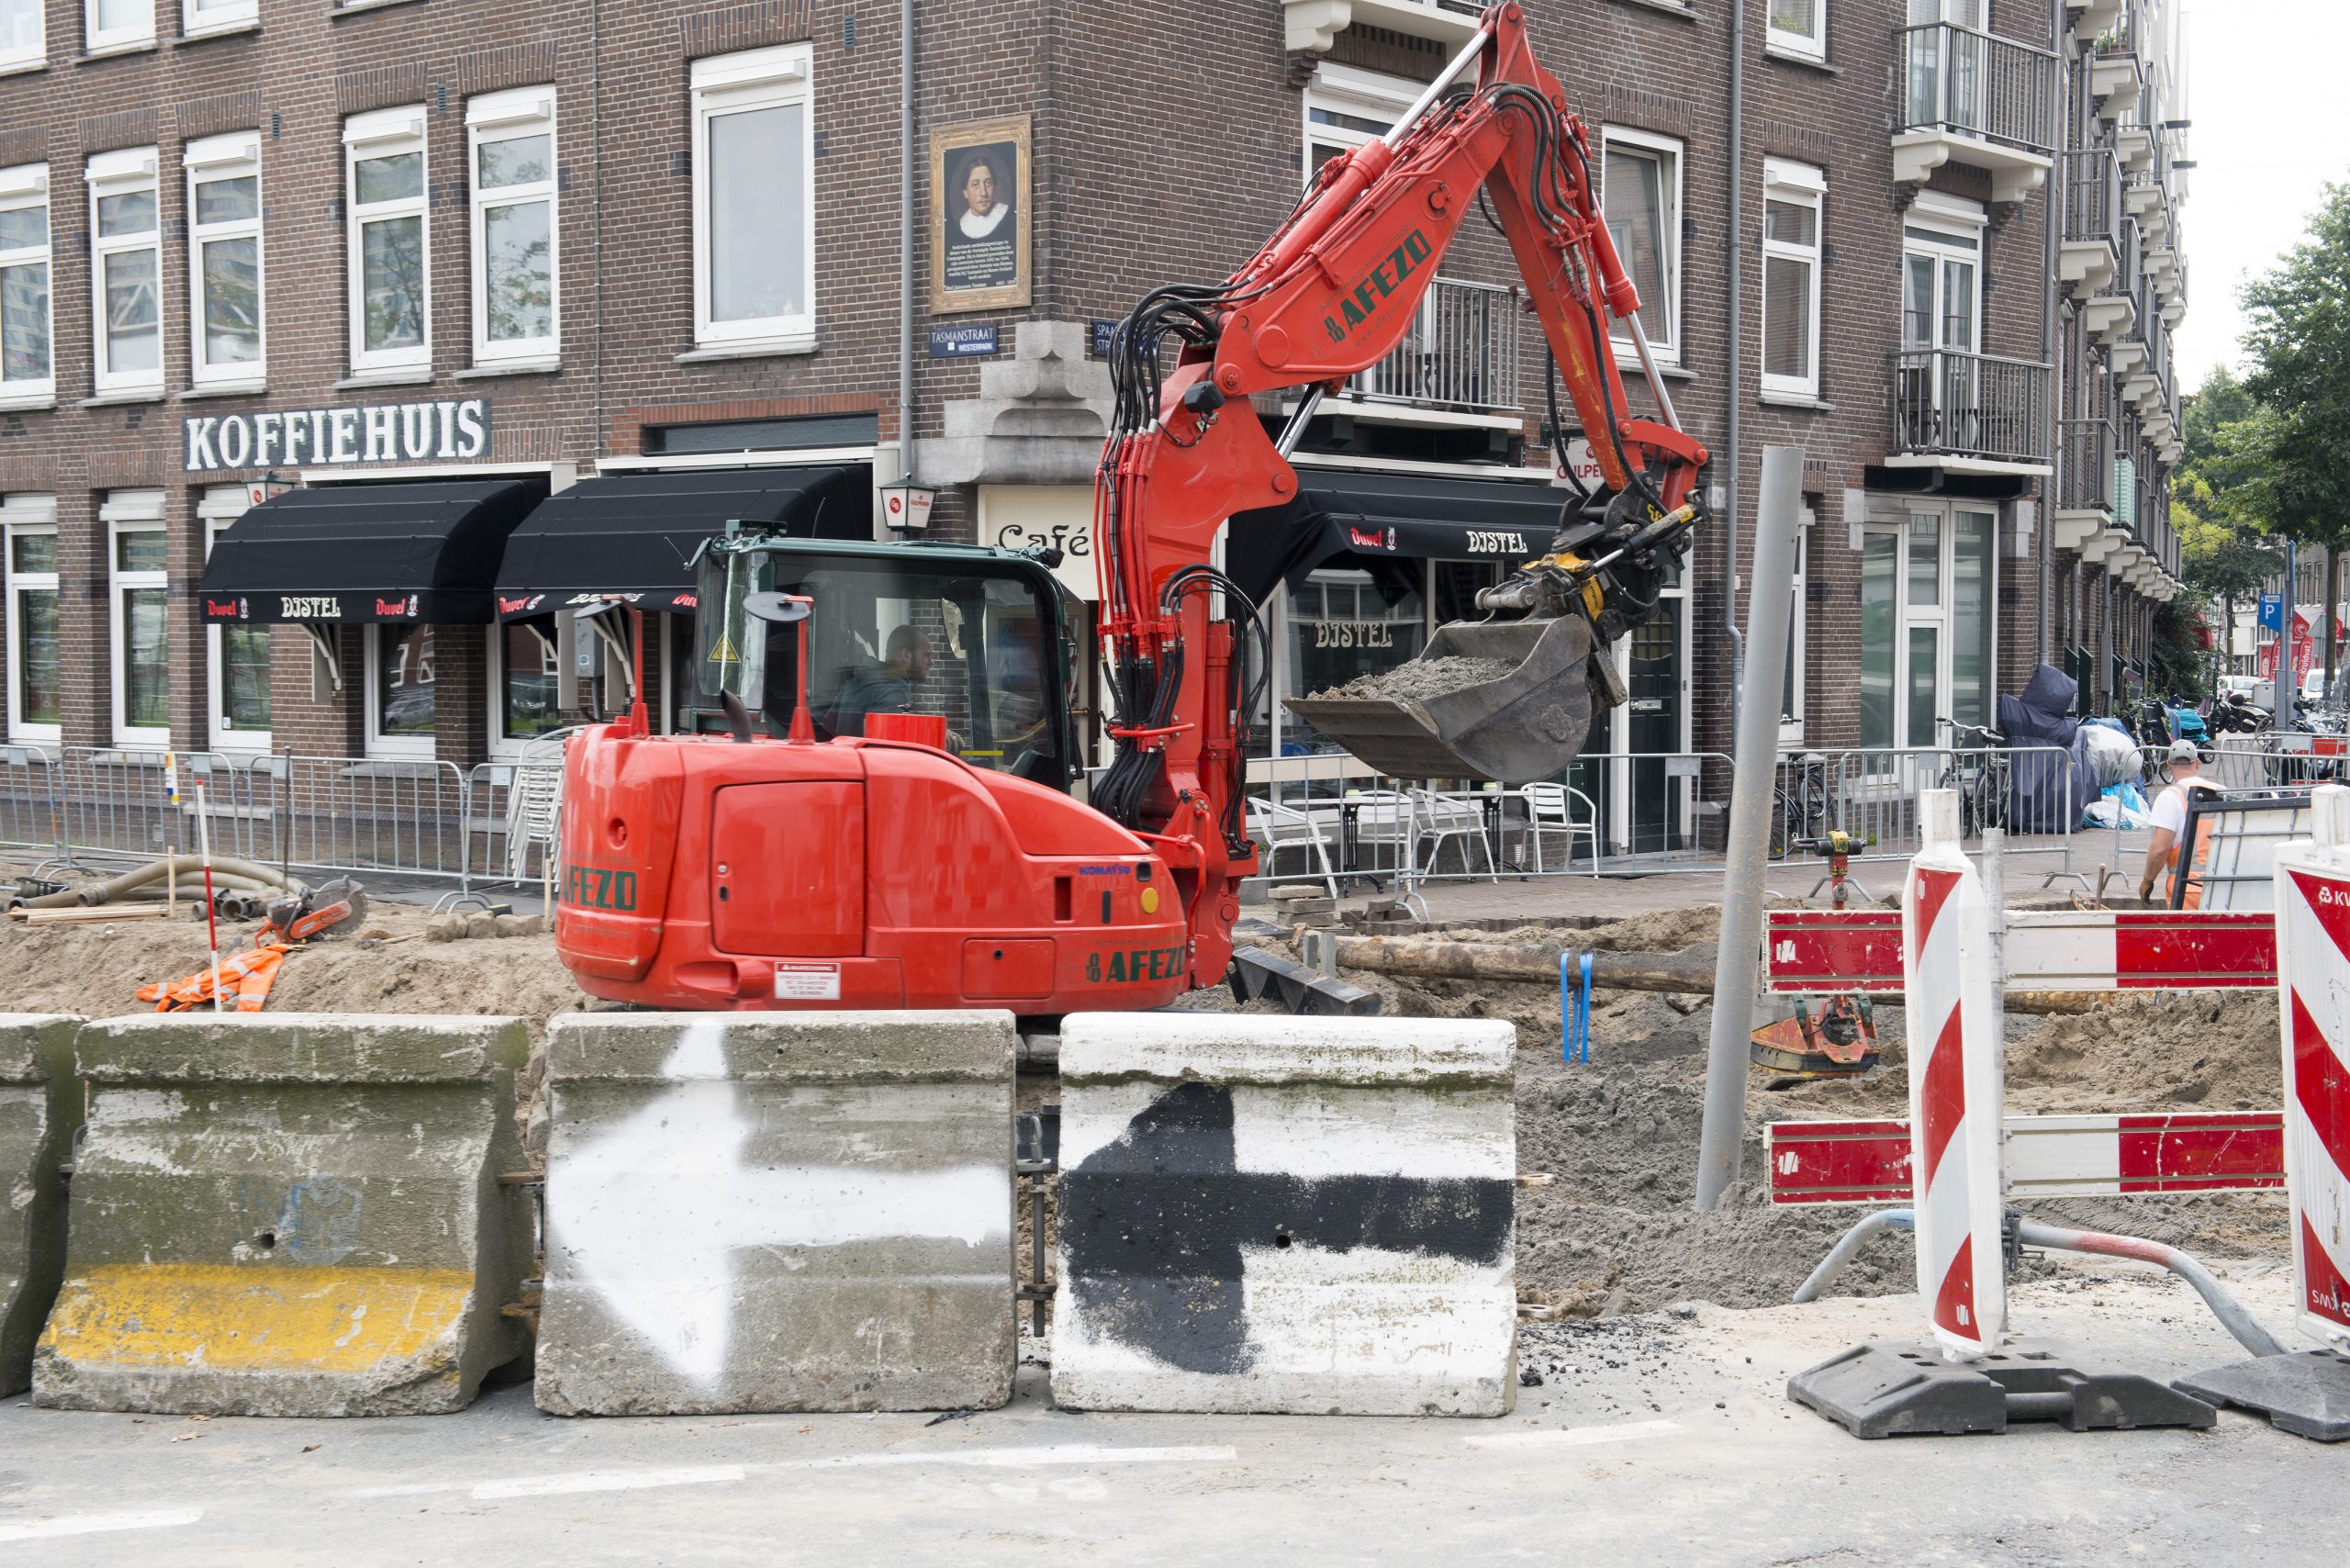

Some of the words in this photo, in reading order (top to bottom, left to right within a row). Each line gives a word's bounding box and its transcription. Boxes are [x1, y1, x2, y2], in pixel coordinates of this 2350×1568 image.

[1340, 229, 1432, 332] AFEZO
[931, 327, 994, 343] TASMANSTRAAT
[957, 342, 993, 353] WESTERPARK
[185, 398, 485, 471] KOFFIEHUIS
[993, 523, 1091, 557] Café
[1350, 526, 1382, 548] Duvel
[207, 599, 237, 617] Duvel
[375, 598, 407, 617] Duvel
[498, 596, 530, 618] Duvel
[2266, 605, 2275, 620] P
[2300, 644, 2311, 675] Kruidvat
[1080, 865, 1131, 875] KOMATSU
